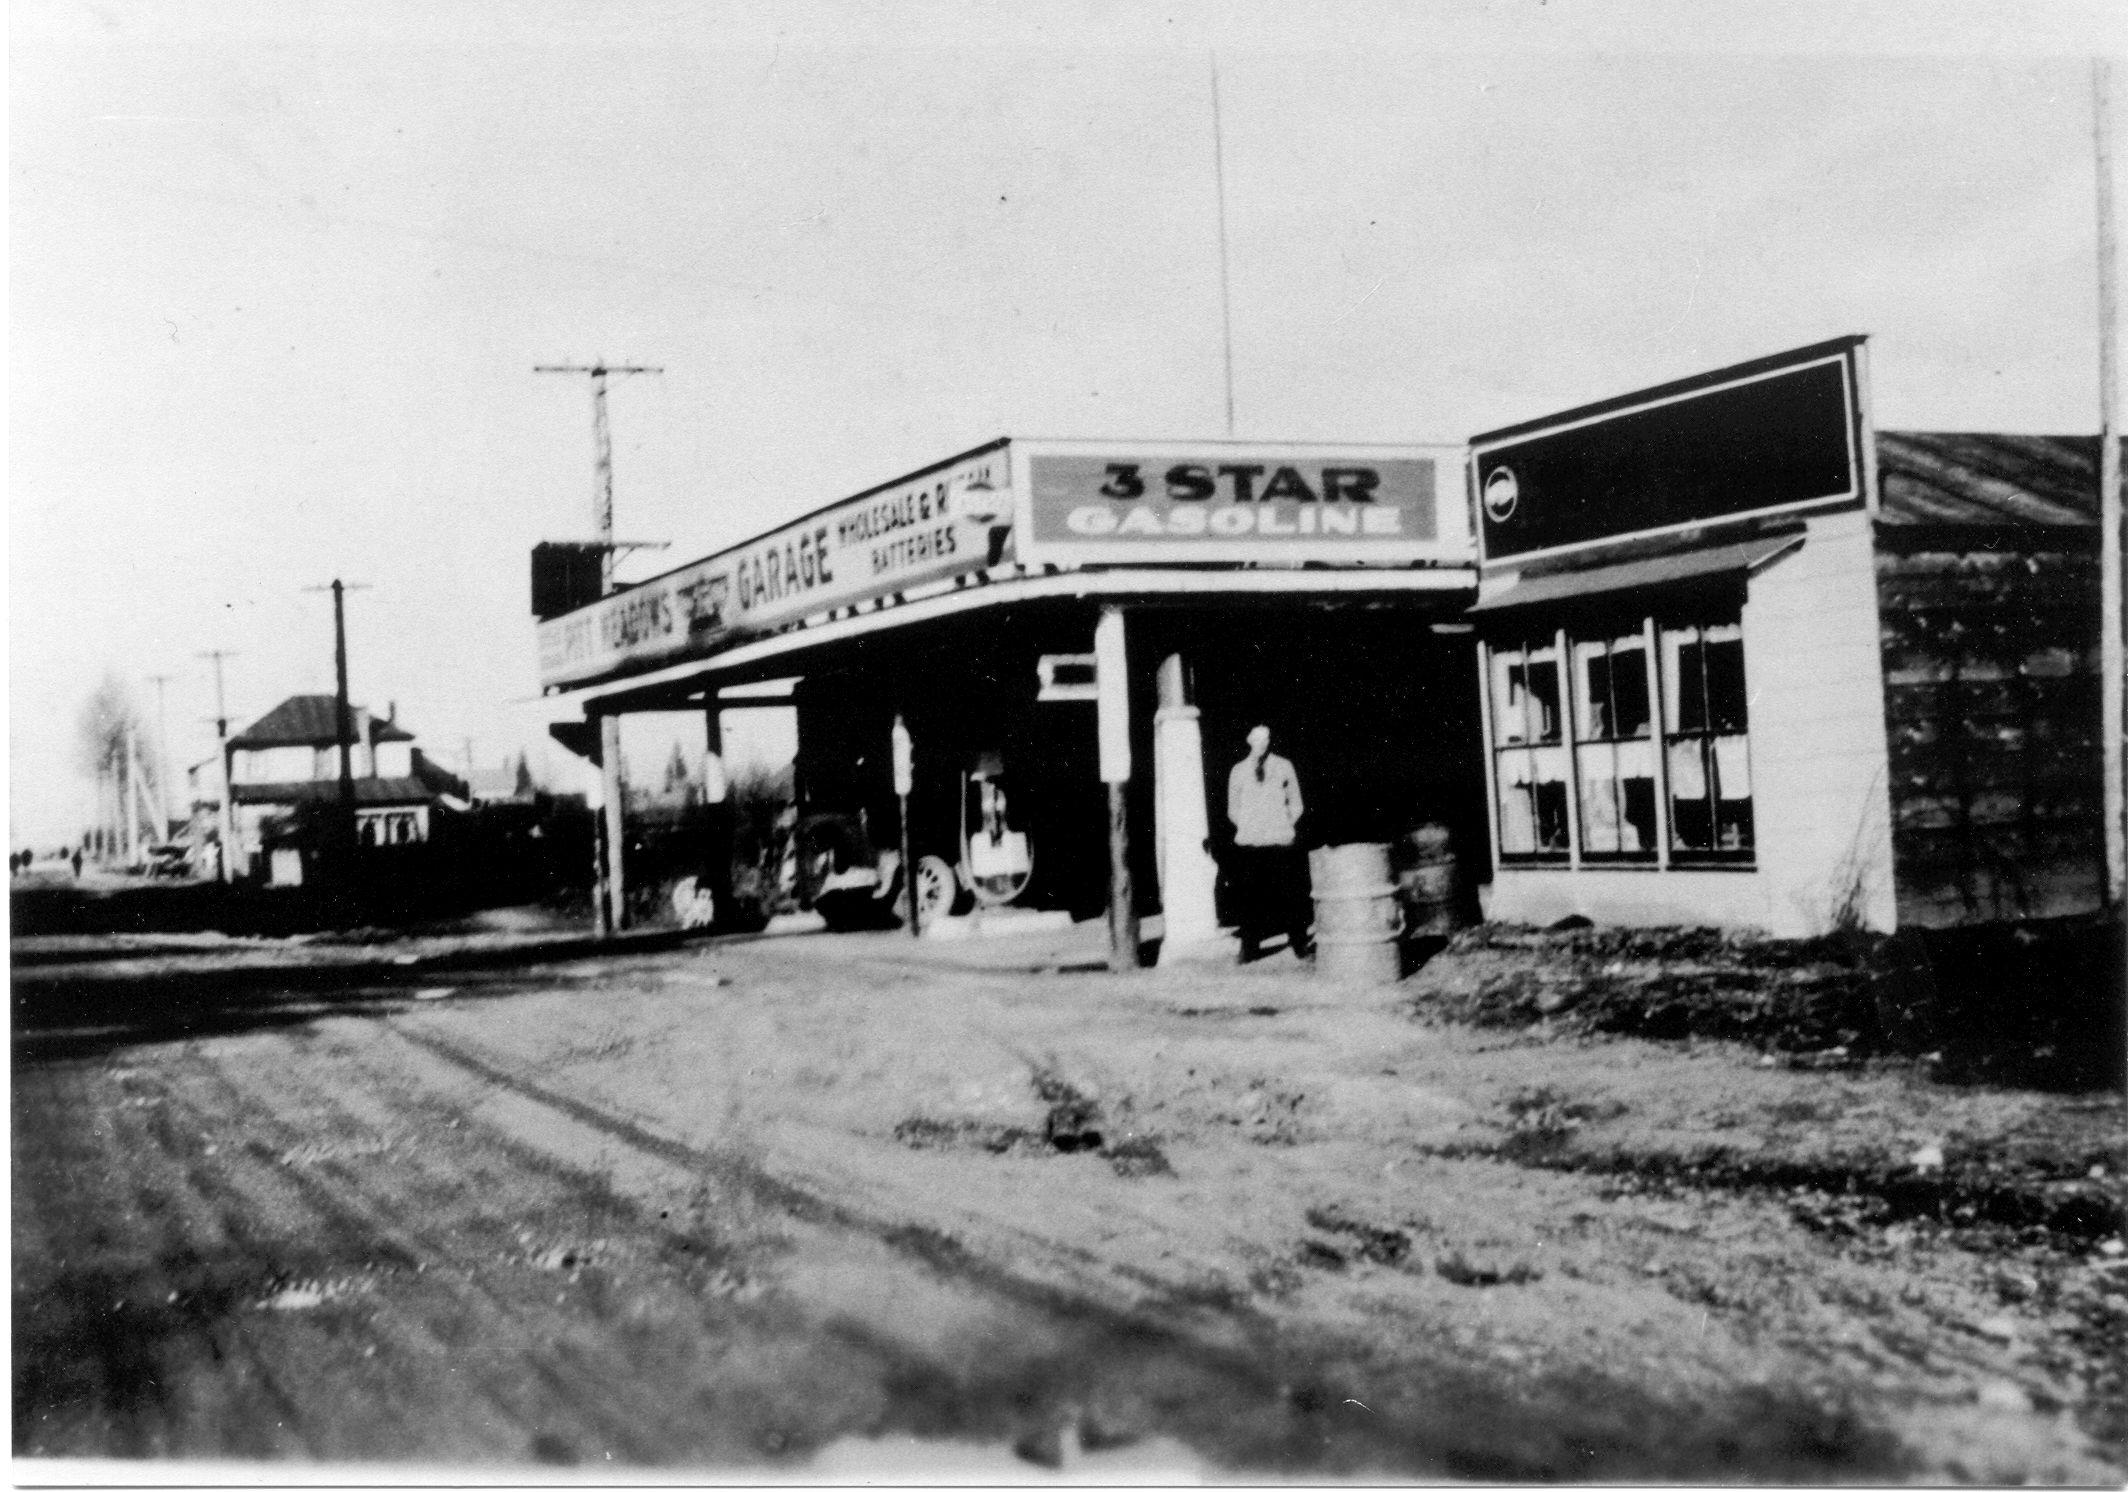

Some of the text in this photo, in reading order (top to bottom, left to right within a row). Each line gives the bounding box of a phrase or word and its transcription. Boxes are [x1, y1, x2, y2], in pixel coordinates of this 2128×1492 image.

[1100, 463, 1381, 503] 3 STAR
[839, 492, 930, 546] WHOLESALE &
[1066, 505, 1401, 535] GASOLINE
[871, 524, 956, 576] BATTERIES
[602, 590, 674, 650] MEADOWS
[738, 527, 833, 610] GARAGE
